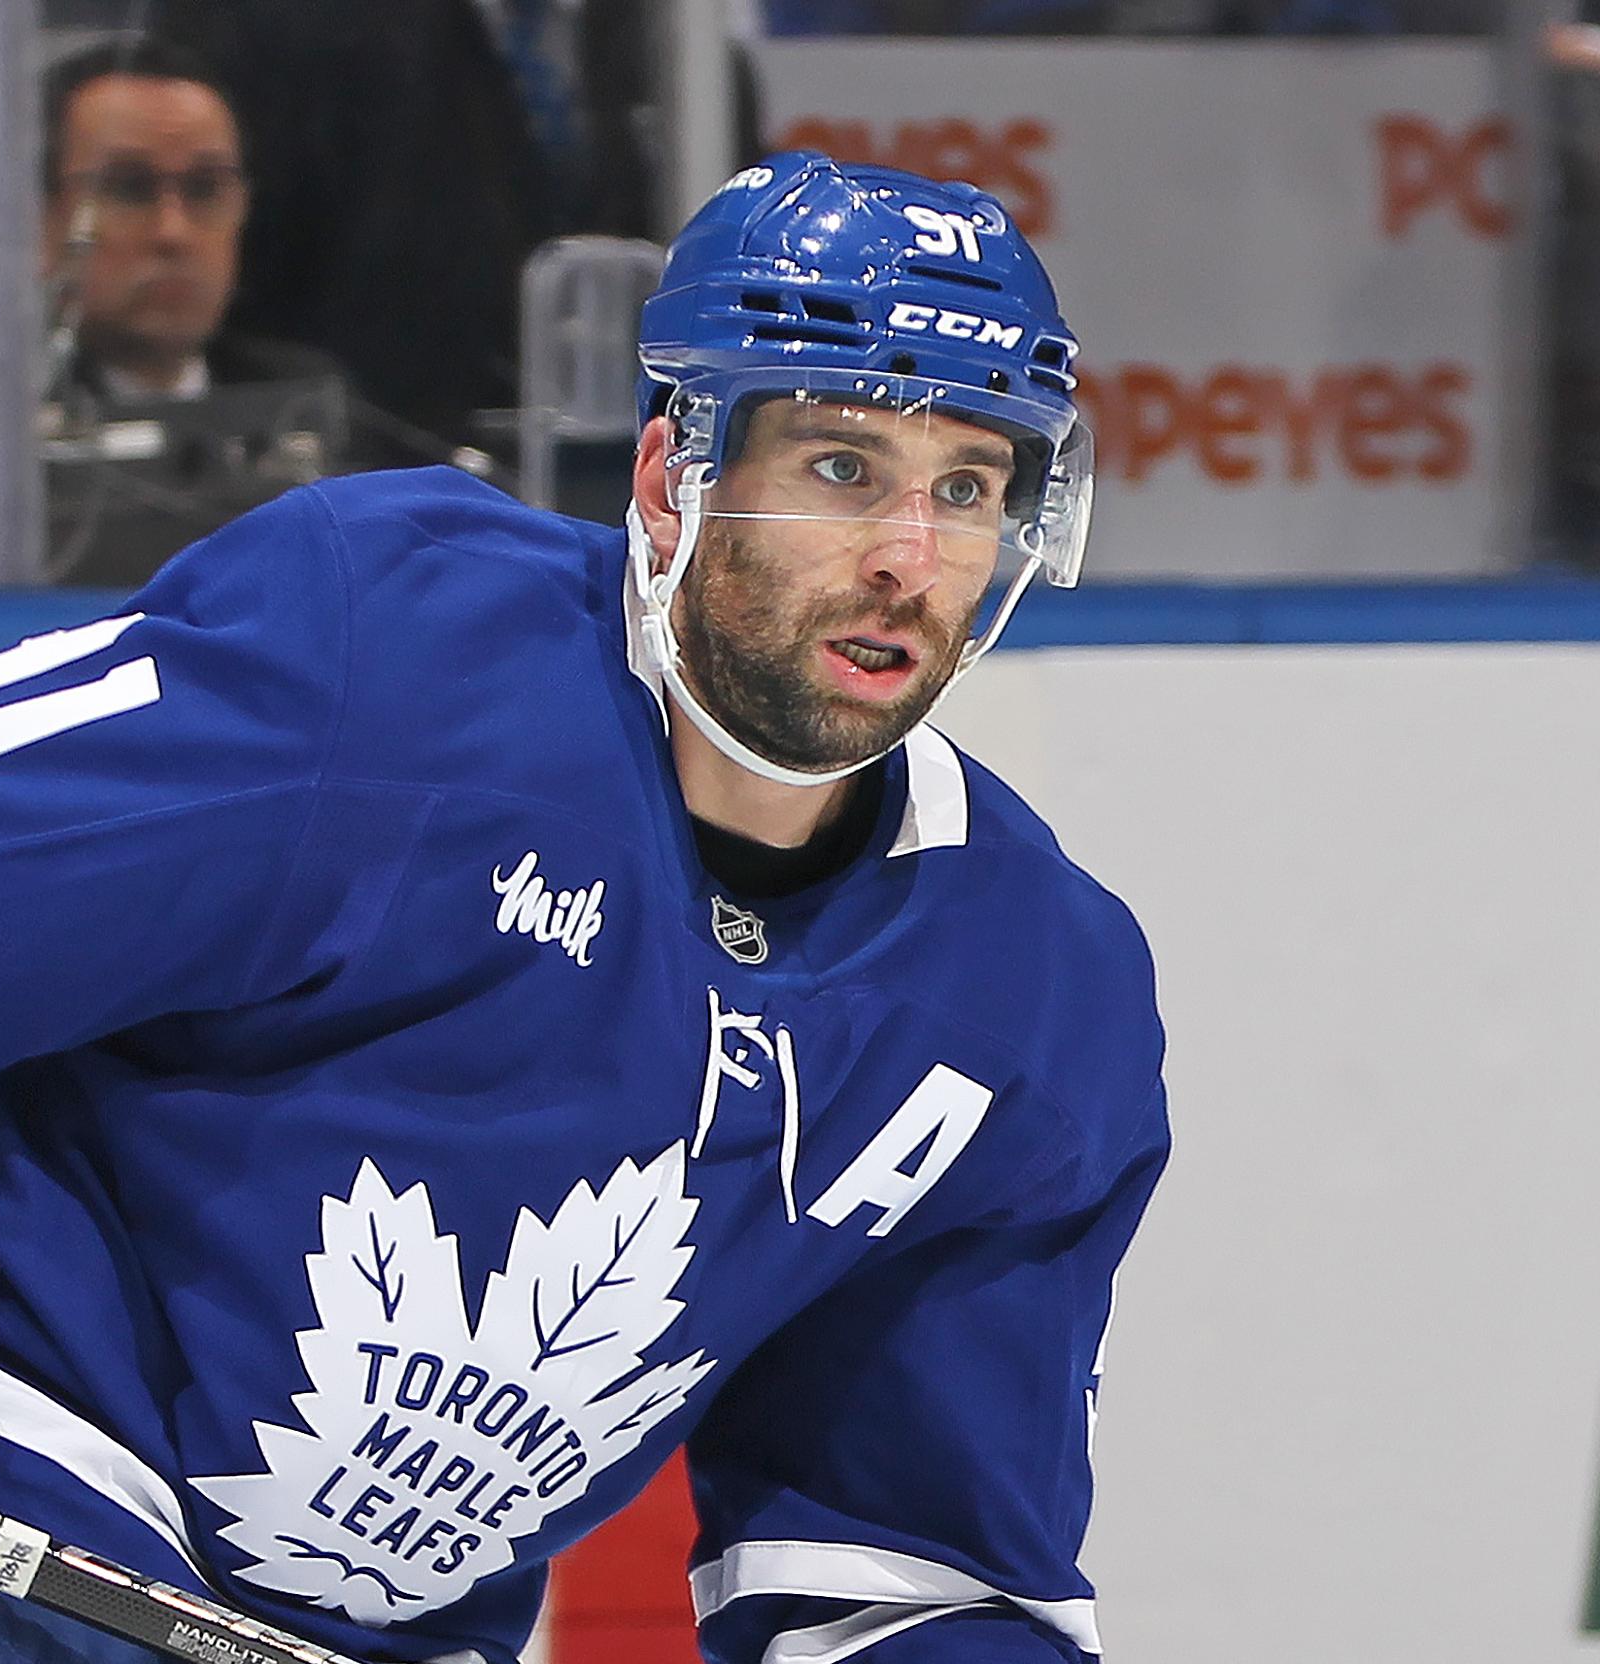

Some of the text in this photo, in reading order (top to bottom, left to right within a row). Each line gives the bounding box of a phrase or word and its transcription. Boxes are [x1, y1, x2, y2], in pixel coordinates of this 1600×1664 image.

[903, 205, 981, 262] 91
[888, 302, 1024, 350] CCM
[665, 447, 693, 470] CCM
[492, 850, 606, 968] Milk
[722, 923, 753, 941] NHL
[805, 1062, 995, 1238] A
[351, 1411, 530, 1529] MAPLE
[357, 1342, 588, 1500] TORONTO
[307, 1464, 481, 1576] LEAFS
